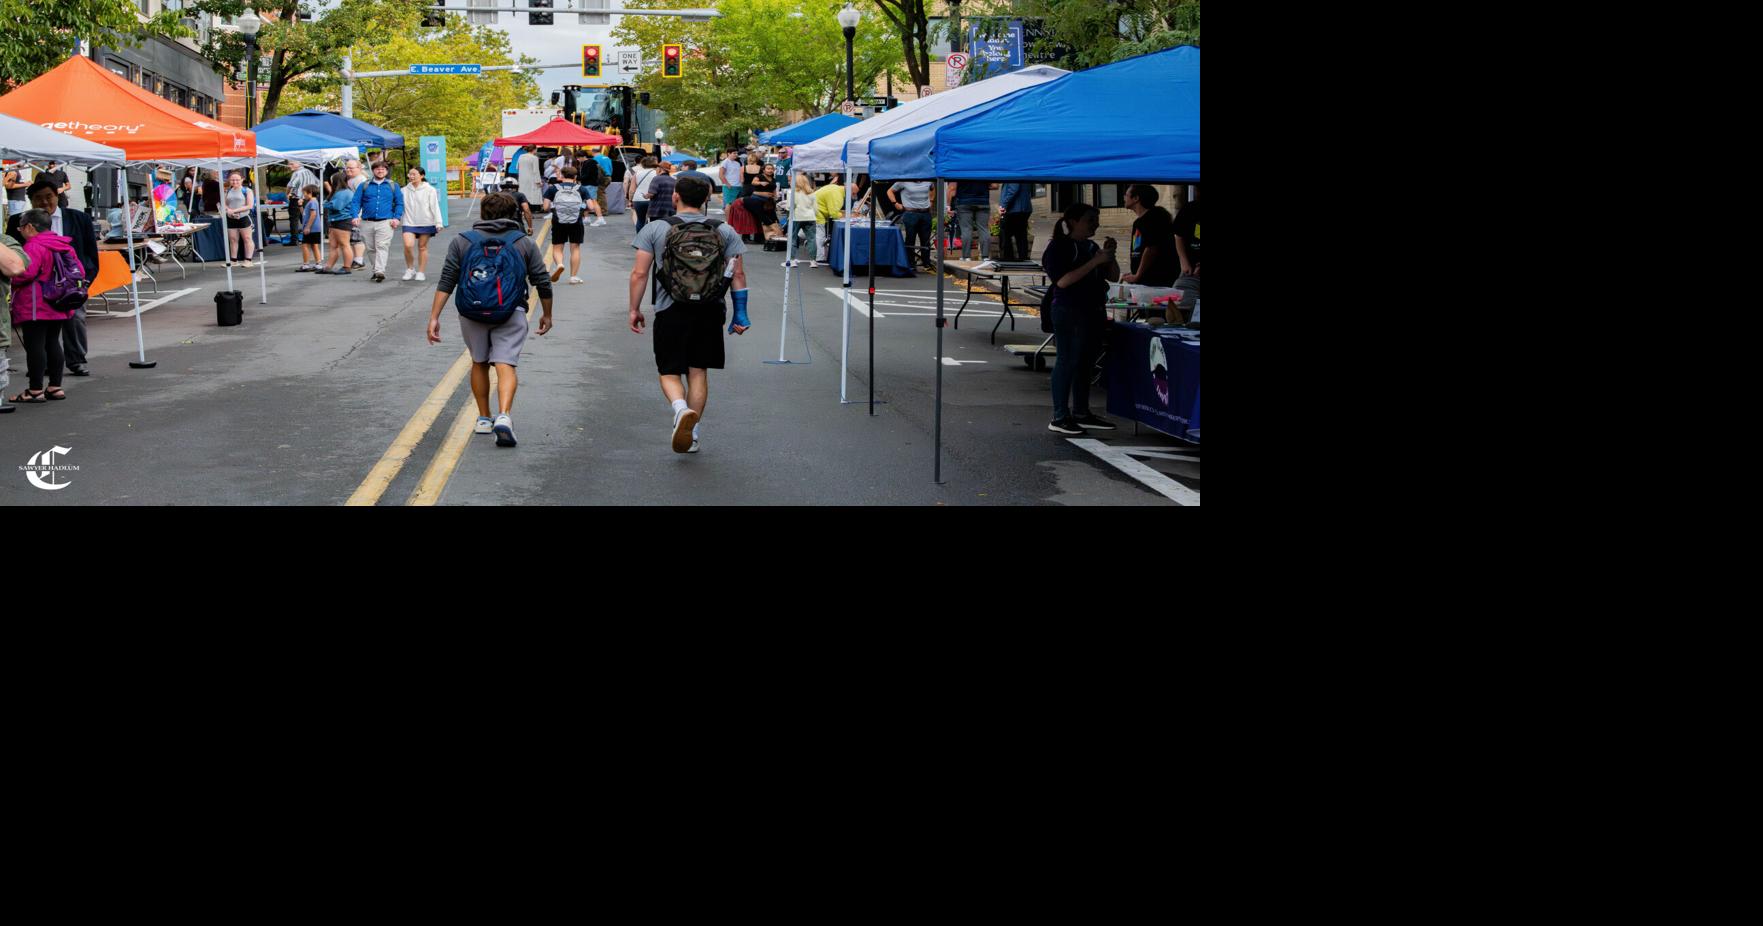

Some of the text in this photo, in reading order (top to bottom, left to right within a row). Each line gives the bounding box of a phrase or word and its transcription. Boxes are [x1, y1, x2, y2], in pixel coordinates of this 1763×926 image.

[410, 65, 481, 73] E. Beaver Ave.
